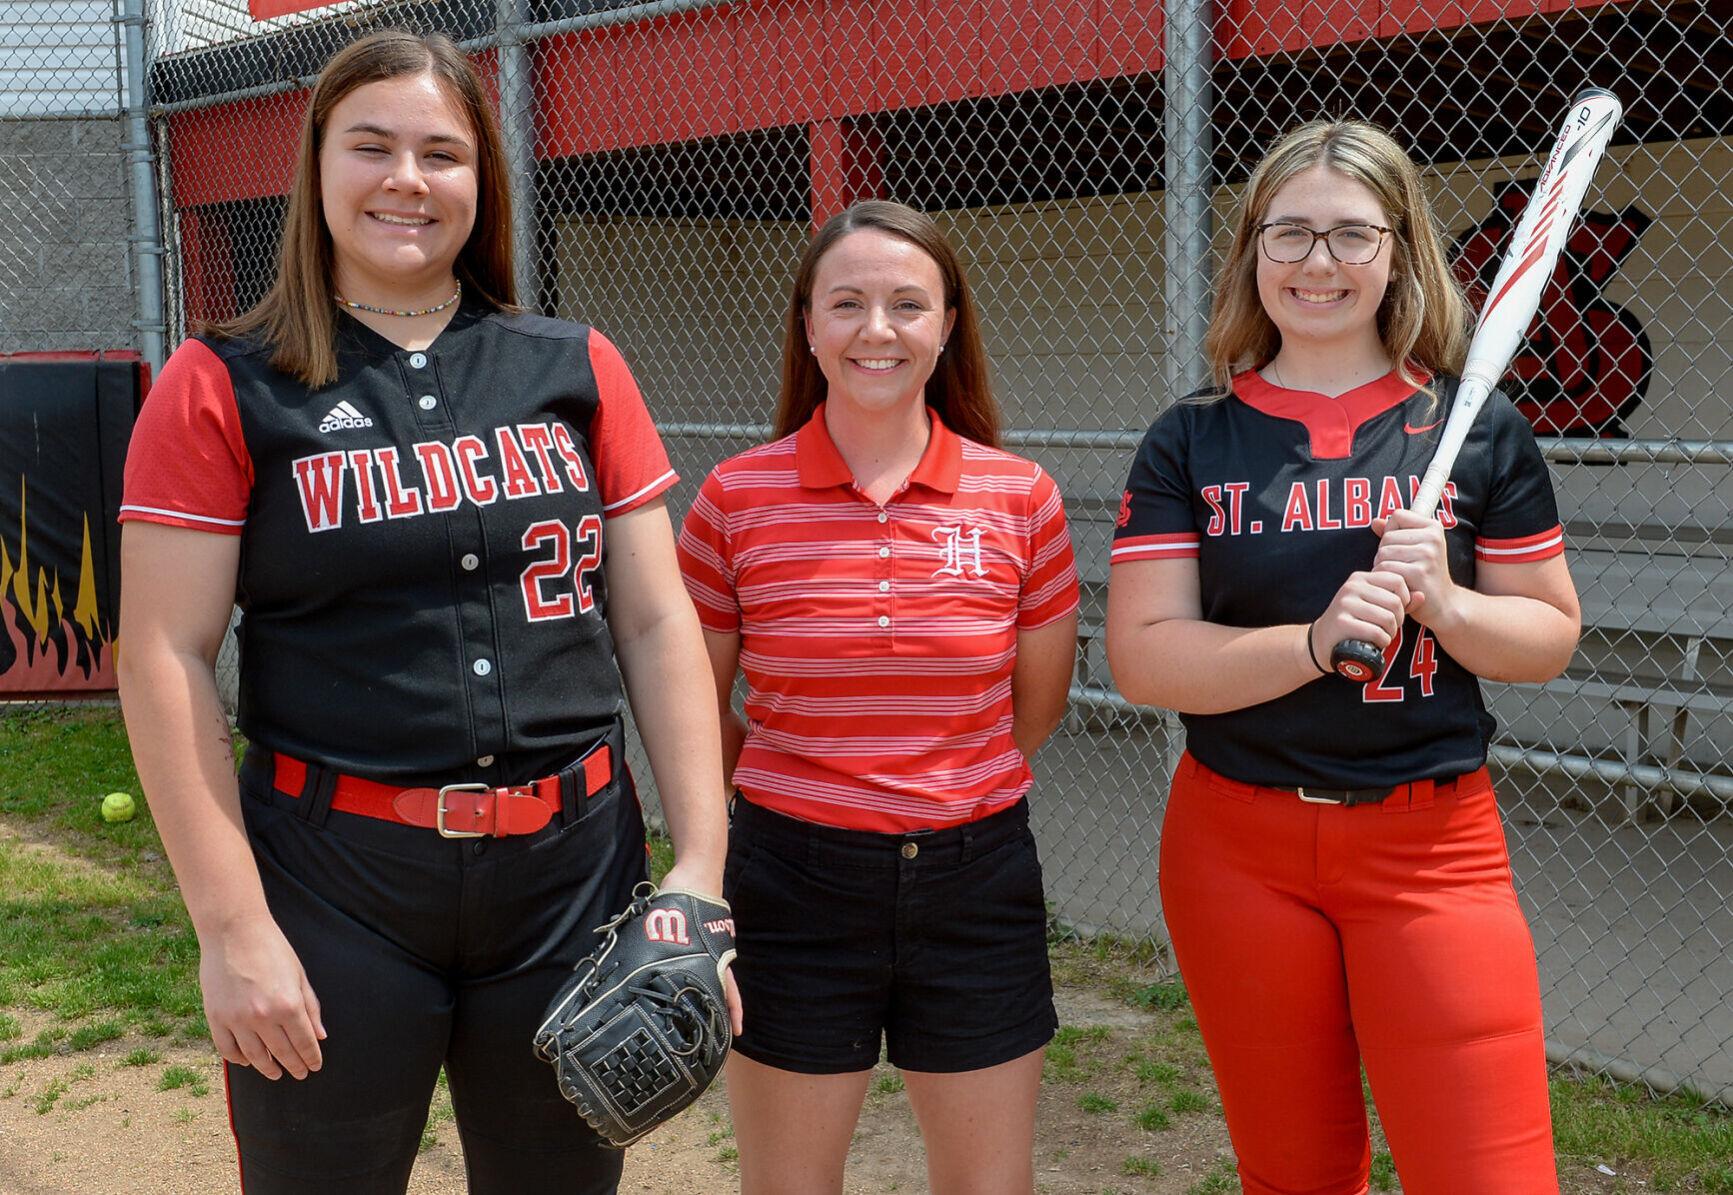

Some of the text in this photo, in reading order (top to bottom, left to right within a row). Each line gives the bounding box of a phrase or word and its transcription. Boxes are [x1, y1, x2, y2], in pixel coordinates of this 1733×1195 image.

[319, 416, 373, 434] adidas
[292, 422, 589, 534] WILDCATS
[1201, 482, 1263, 537] ST.
[520, 514, 603, 623] 22
[931, 525, 991, 578] H
